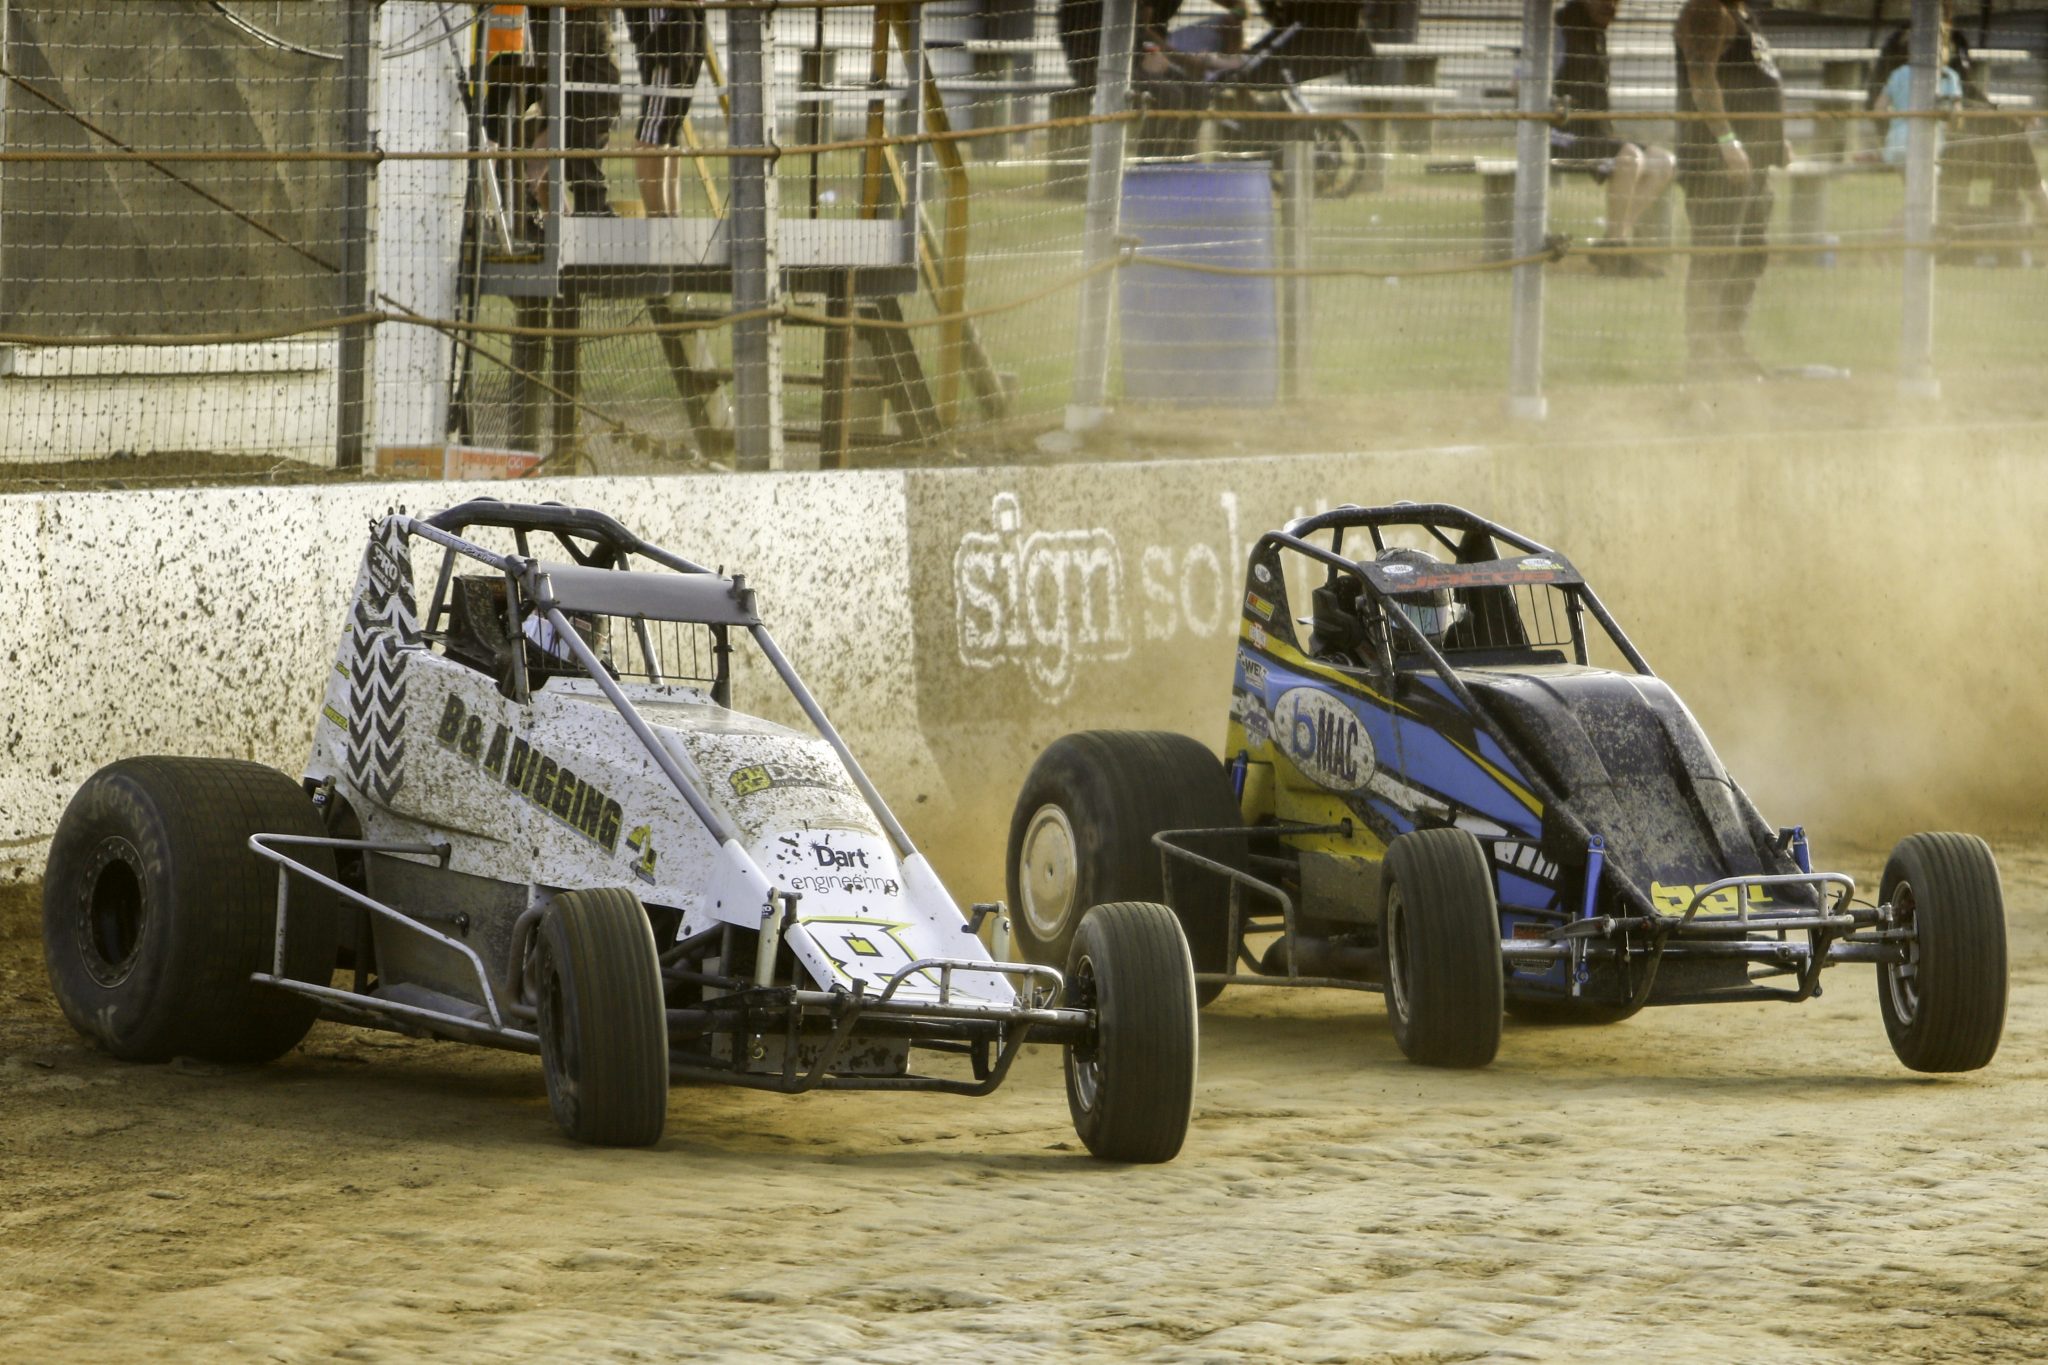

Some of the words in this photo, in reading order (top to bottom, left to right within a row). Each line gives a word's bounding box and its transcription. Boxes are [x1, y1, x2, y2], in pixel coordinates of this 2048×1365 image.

[373, 545, 398, 581] PRO
[957, 492, 1131, 702] sign
[437, 693, 466, 747] B
[460, 714, 483, 760] &
[483, 723, 510, 779] A
[505, 735, 624, 854] DIGGING
[815, 845, 869, 869] Dart
[791, 875, 900, 897] engineering
